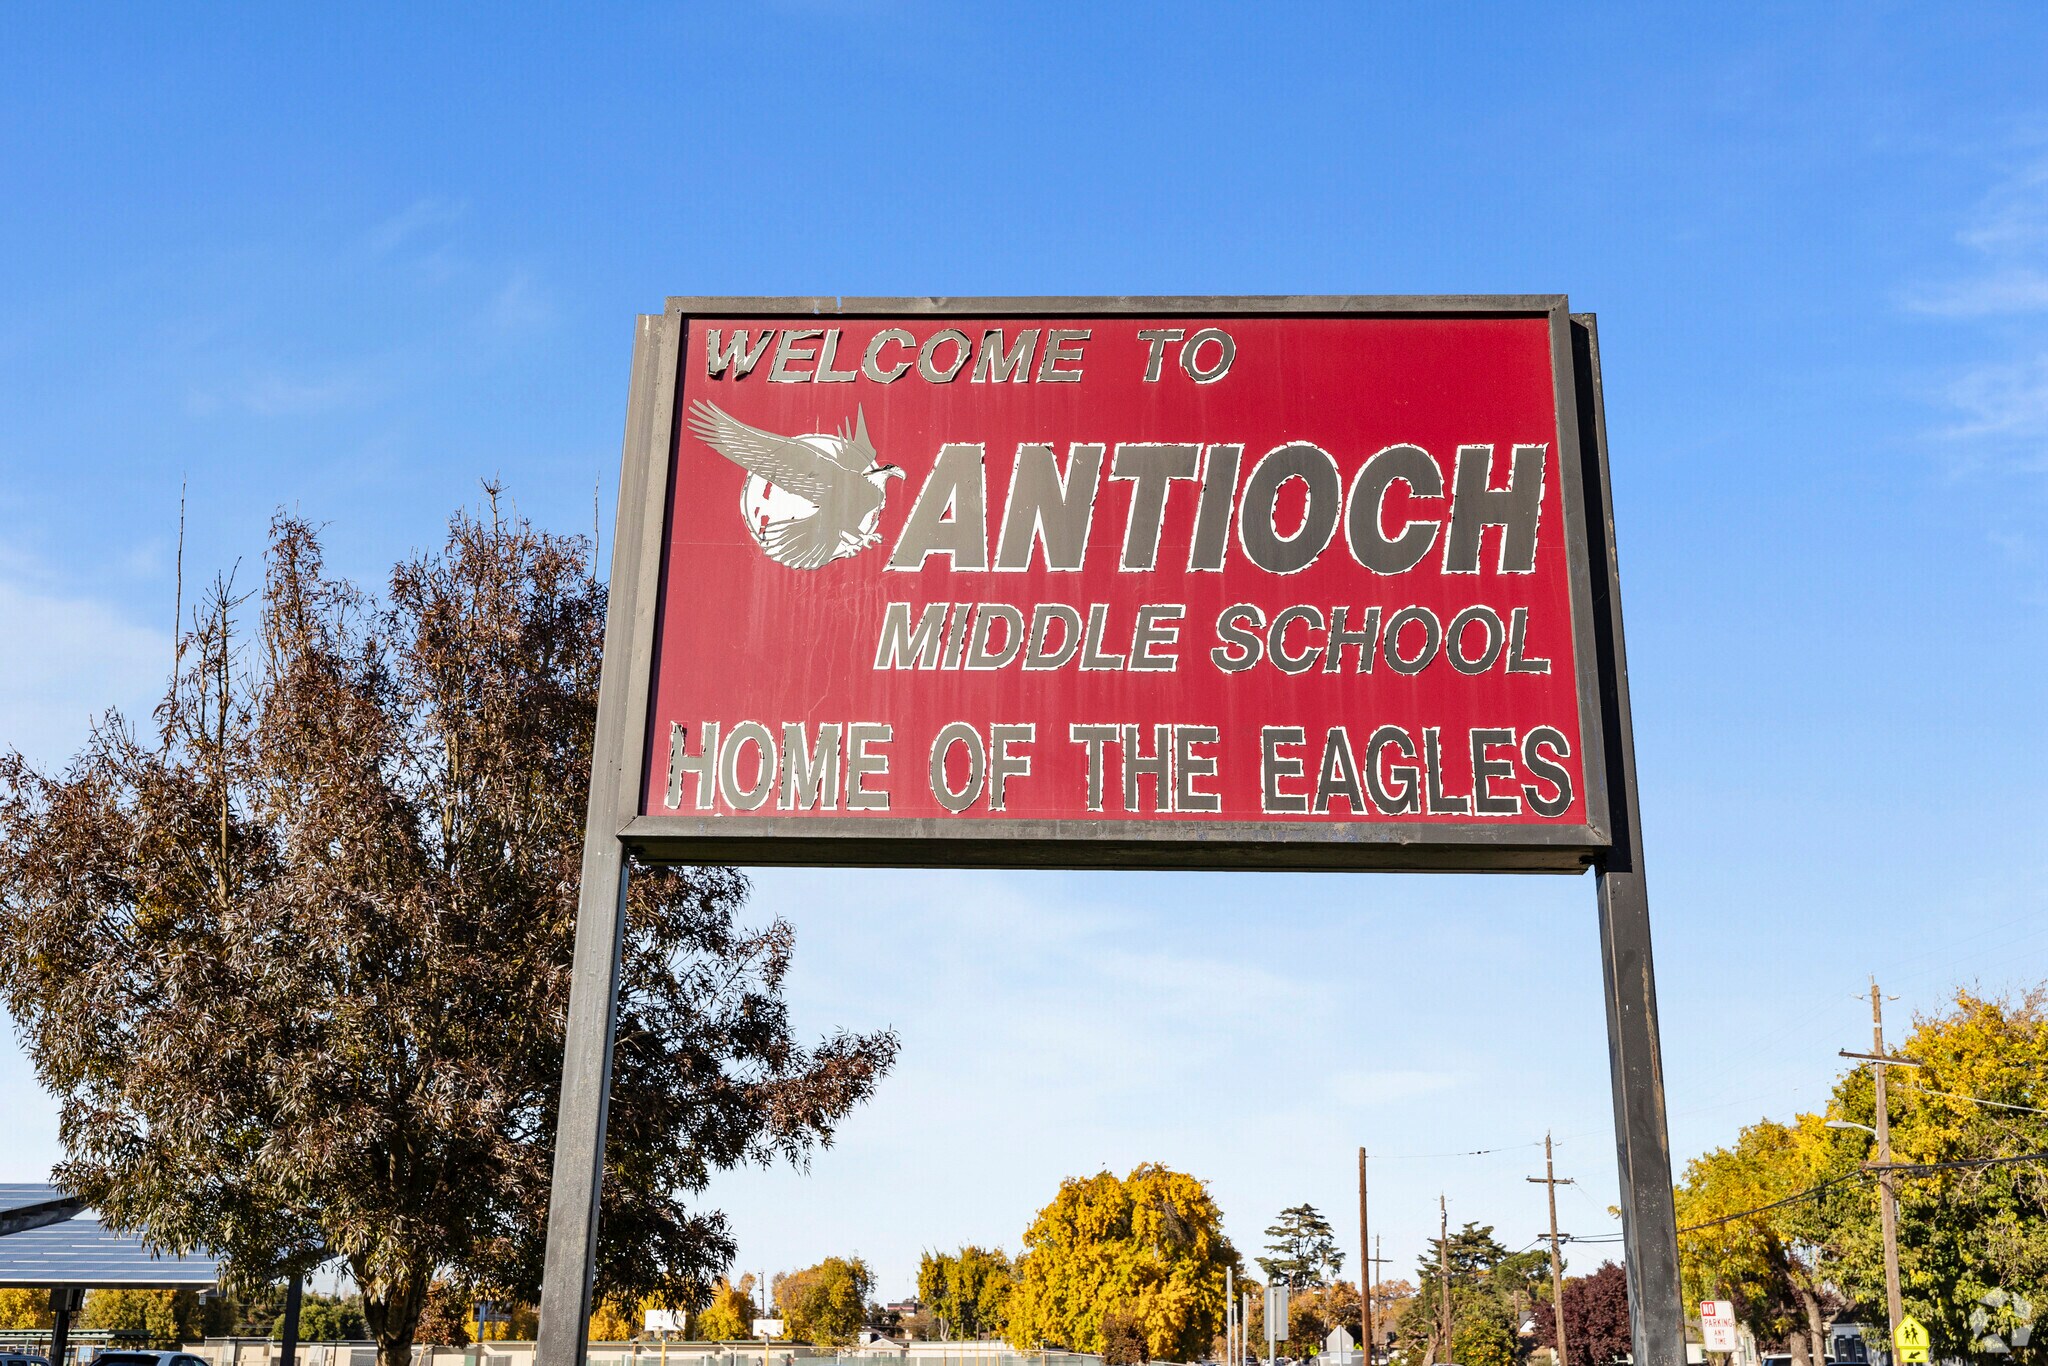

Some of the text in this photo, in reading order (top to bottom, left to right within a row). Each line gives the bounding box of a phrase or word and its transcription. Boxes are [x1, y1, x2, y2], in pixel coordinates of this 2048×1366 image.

[706, 328, 1236, 384] WELCOME TO
[884, 440, 1549, 576] ANTIOCH
[873, 601, 1551, 675] MIDDLE SCHOOL
[664, 720, 1575, 818] HOME OF THE EAGLES
[1703, 1303, 1714, 1315] NO
[1704, 1318, 1733, 1327] PARKING
